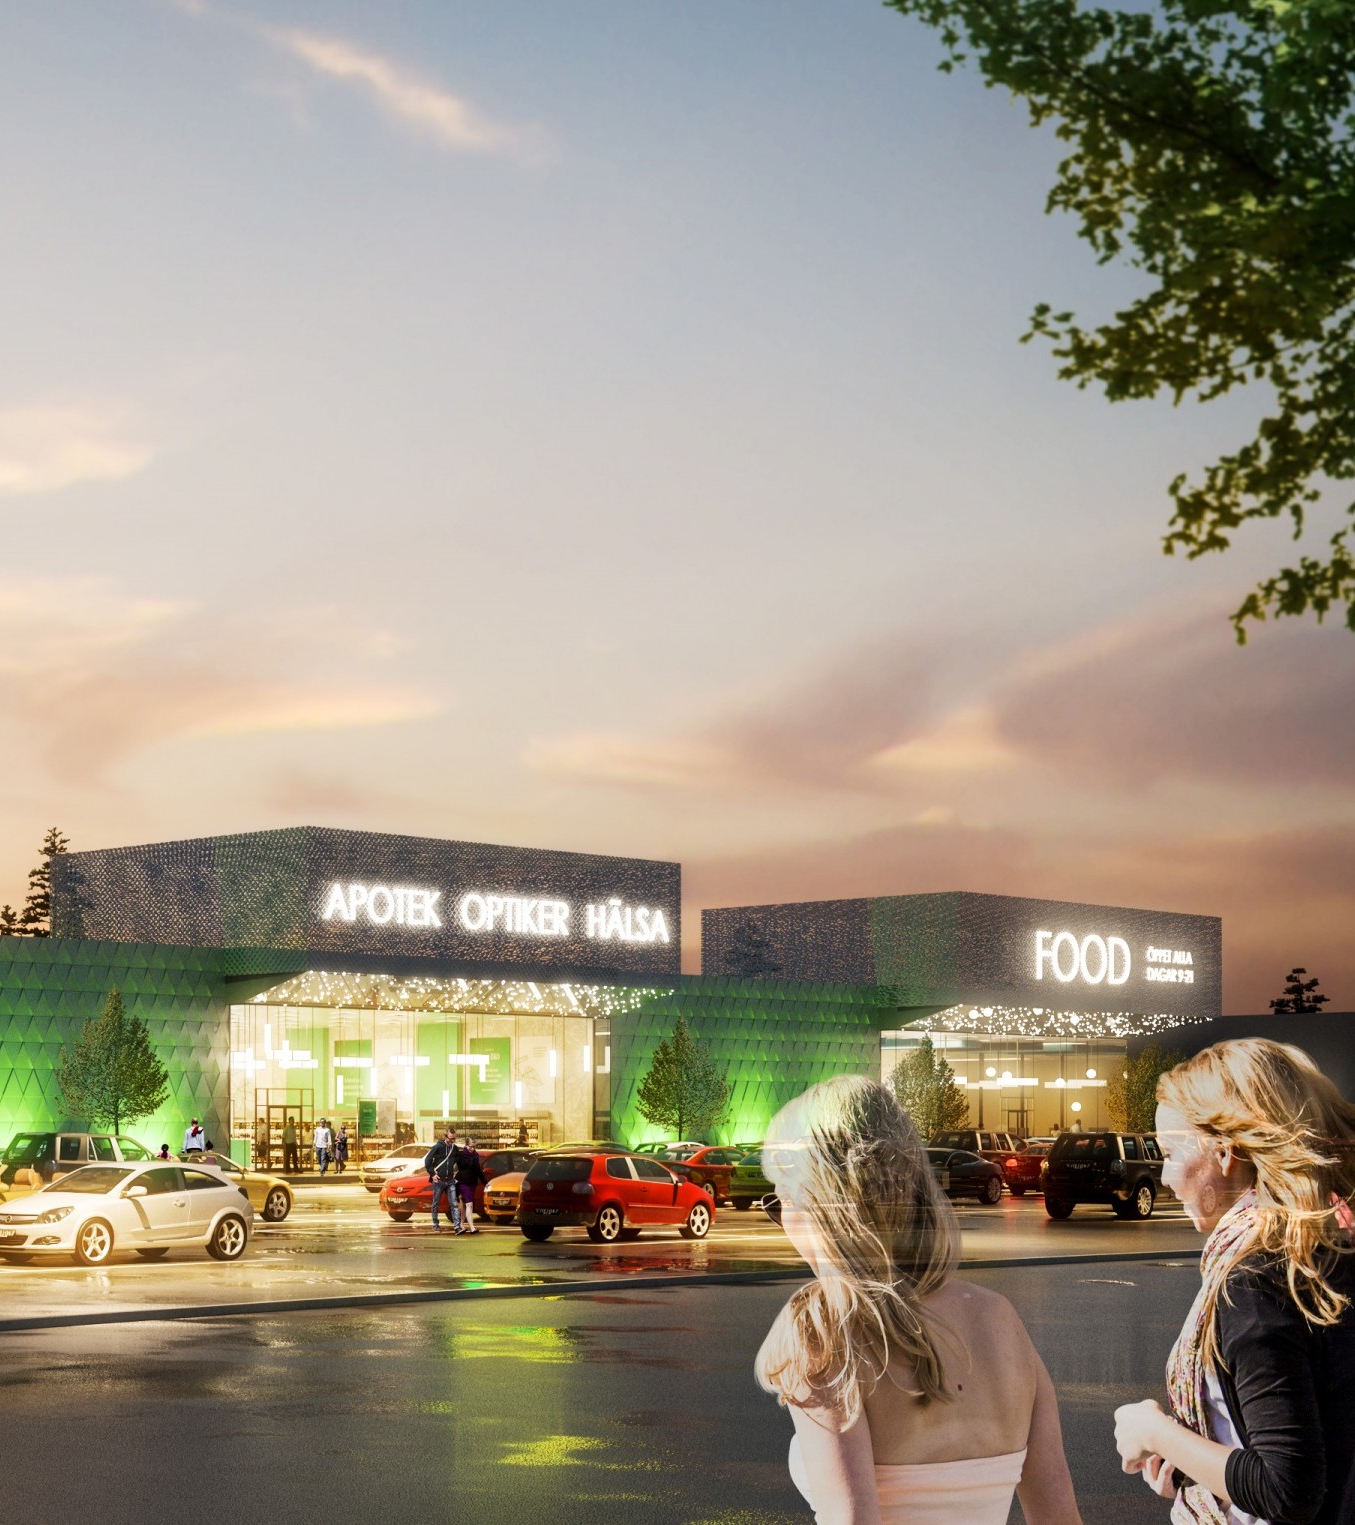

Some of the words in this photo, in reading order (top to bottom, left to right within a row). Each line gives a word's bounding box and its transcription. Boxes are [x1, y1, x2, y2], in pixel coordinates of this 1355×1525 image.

[324, 883, 441, 927] APOTEK
[460, 894, 569, 936] OPTIKER
[586, 899, 670, 943] HÄLSA
[1035, 930, 1131, 985] FOOD
[1146, 967, 1177, 982] DAGAR
[1172, 950, 1193, 965] ALLA
